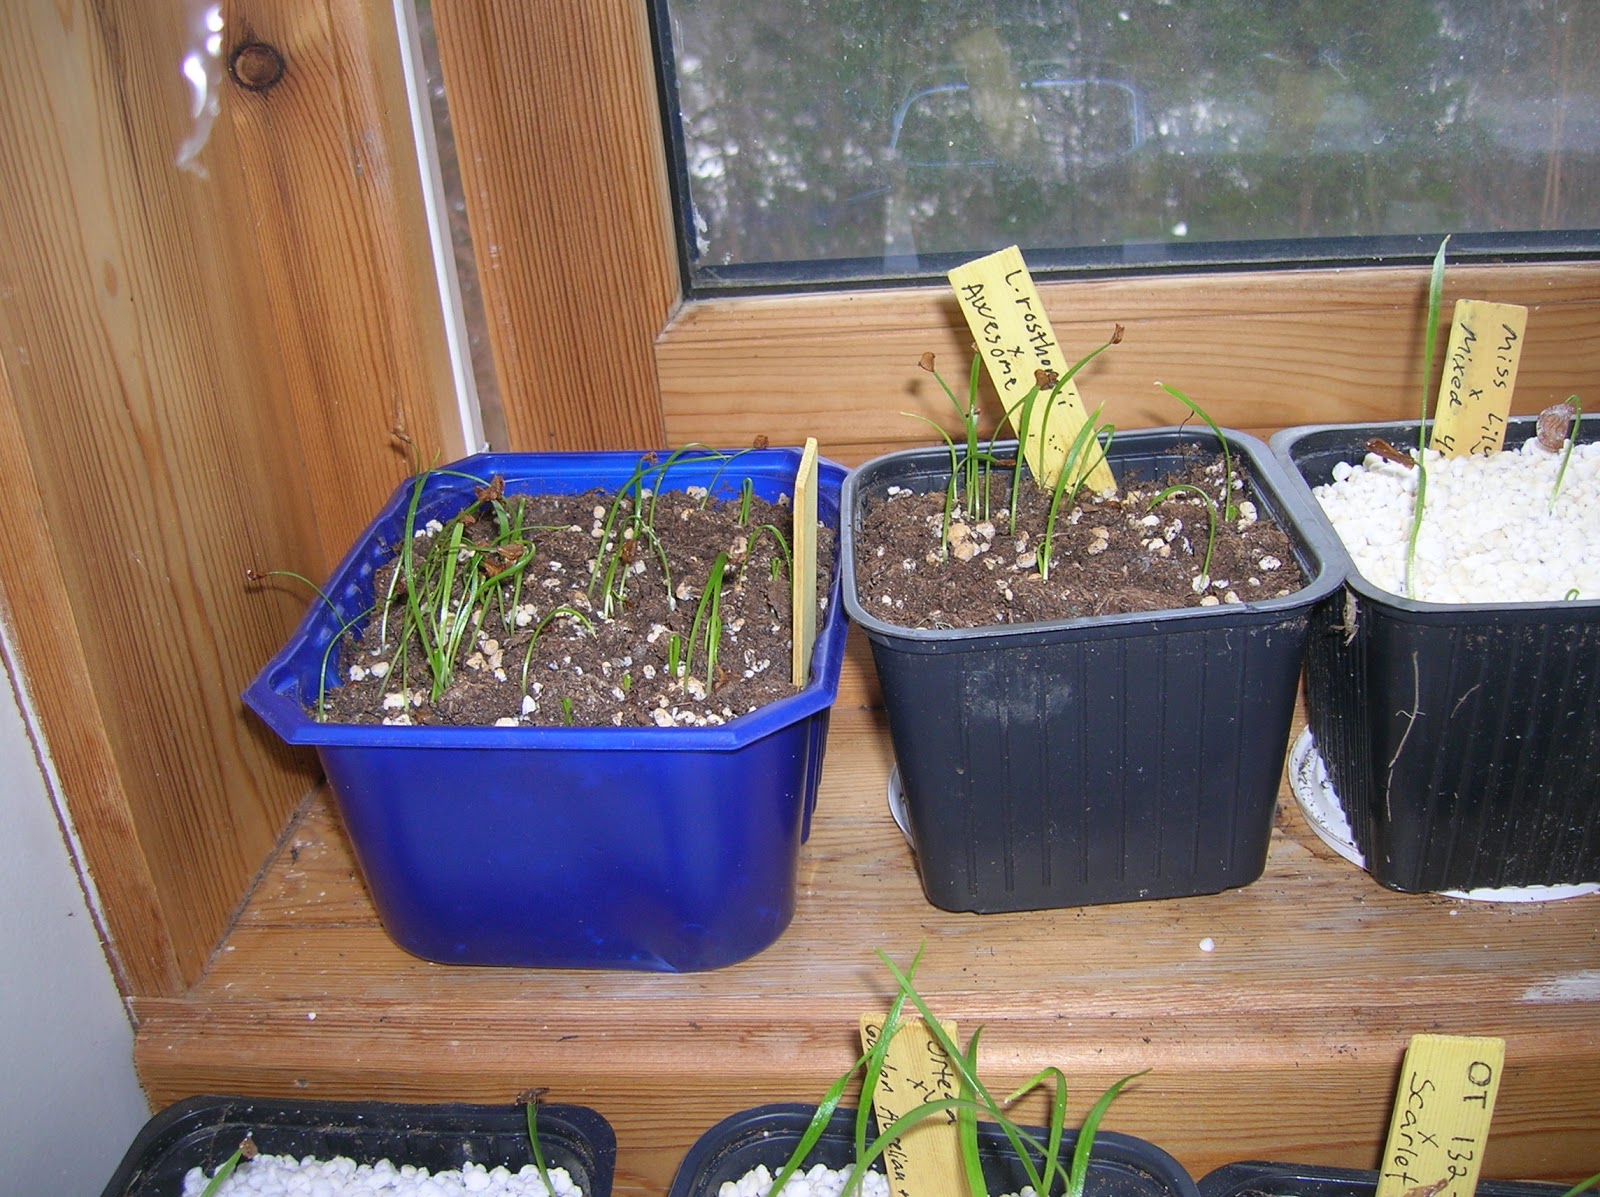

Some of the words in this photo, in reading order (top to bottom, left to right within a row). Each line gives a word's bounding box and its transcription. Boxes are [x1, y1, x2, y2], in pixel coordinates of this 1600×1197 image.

[961, 283, 1018, 392] Awesome
[1449, 323, 1477, 408] Mixed
[1492, 323, 1518, 389] Miss
[1462, 1060, 1492, 1109] OT
[1384, 1071, 1436, 1187] Scarlet
